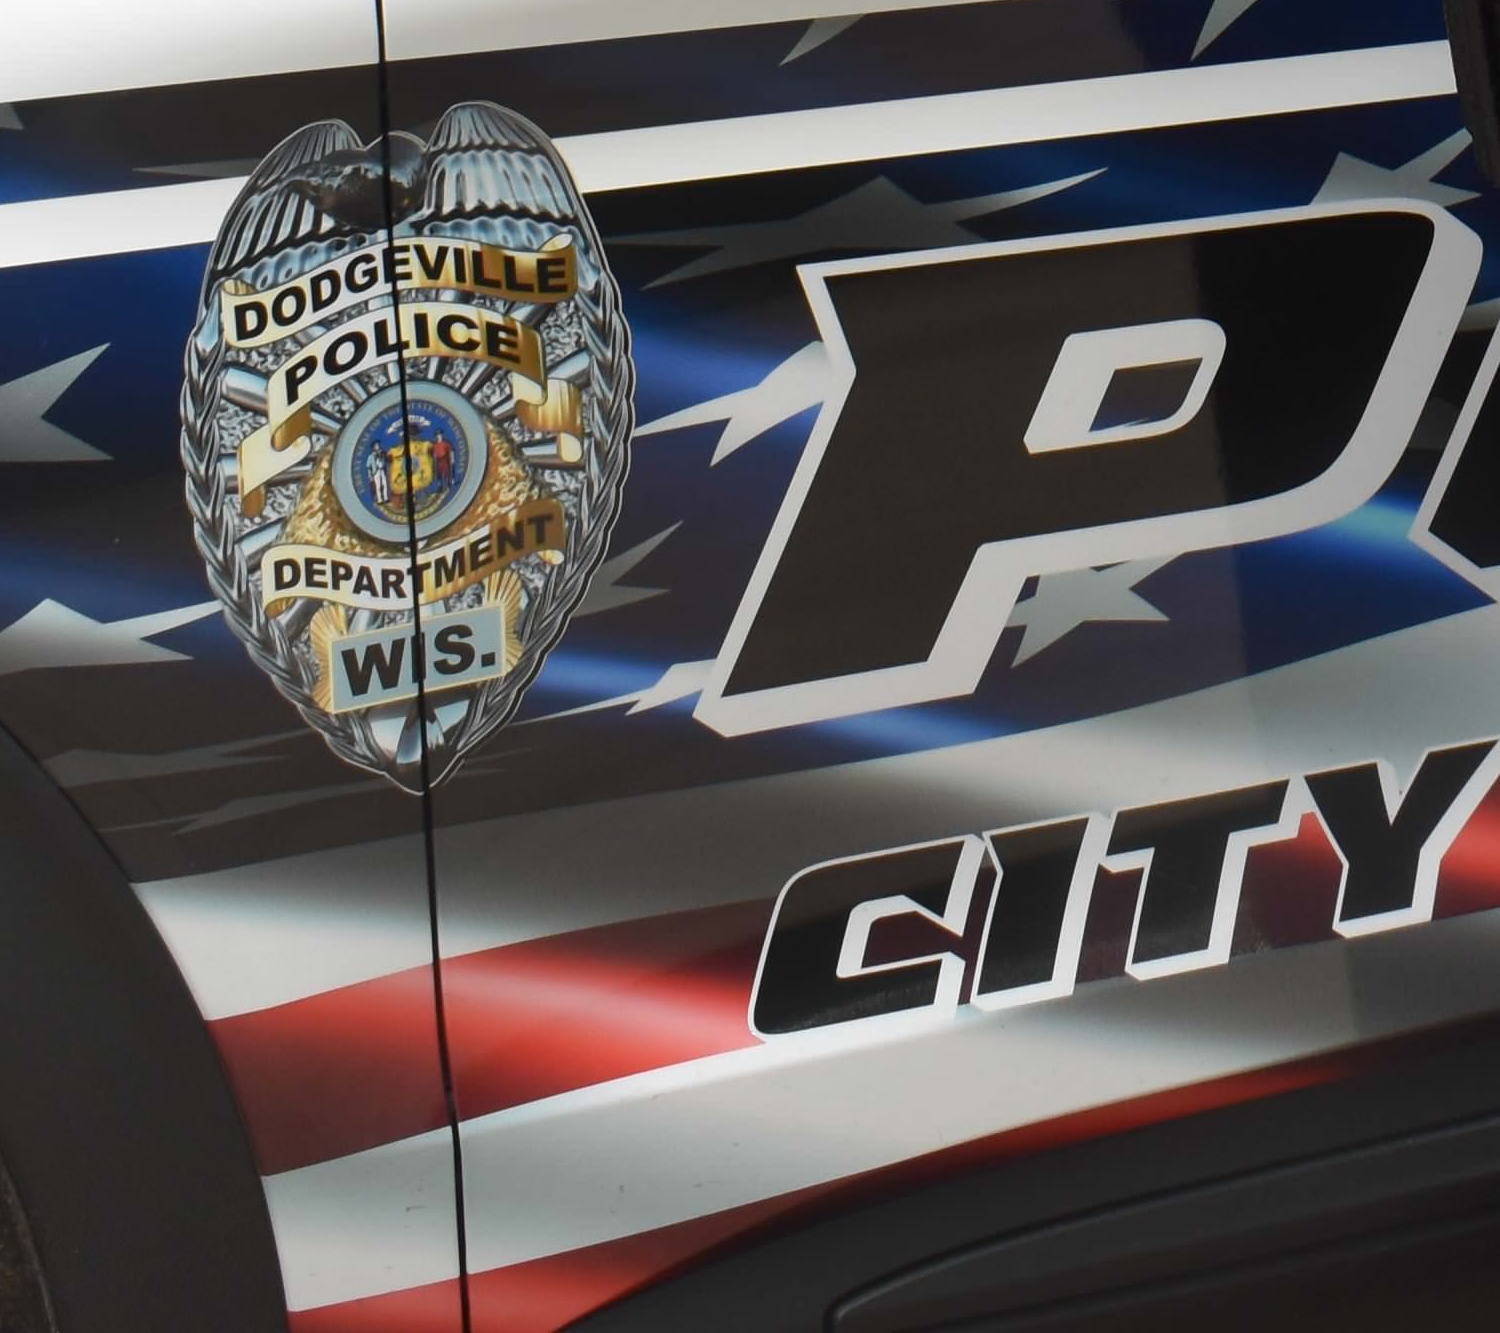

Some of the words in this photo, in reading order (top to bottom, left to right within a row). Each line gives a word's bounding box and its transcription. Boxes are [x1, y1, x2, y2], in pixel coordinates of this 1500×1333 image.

[232, 243, 569, 342] DODGEVILLE
[284, 312, 522, 407] POLICE
[273, 513, 555, 599] DEPARTMENT
[340, 624, 497, 697] WIS.
